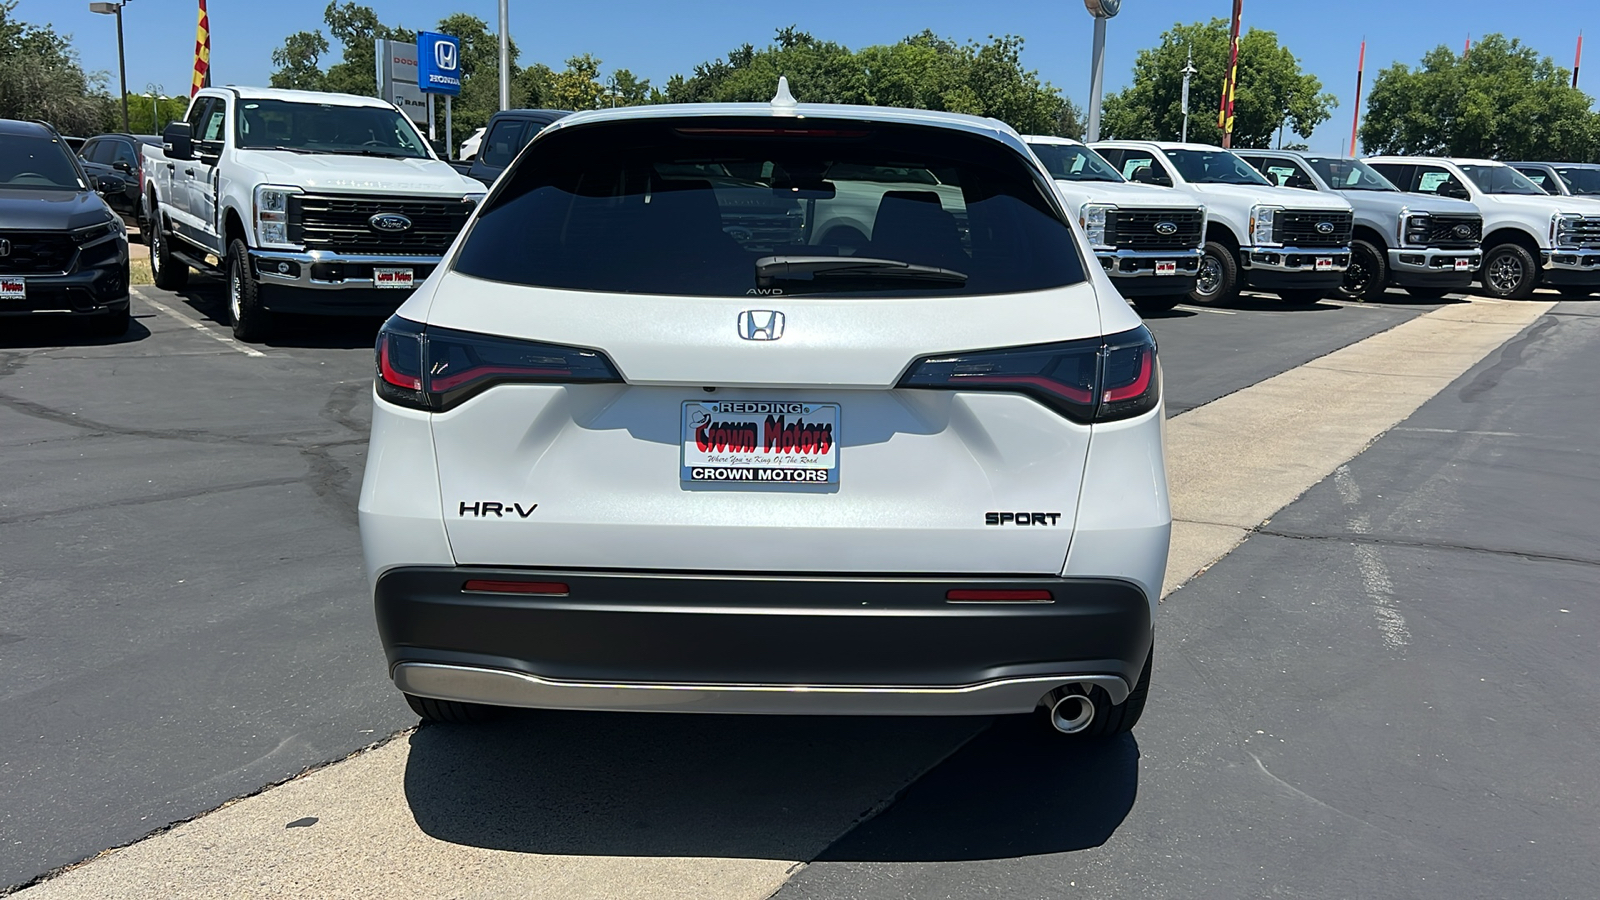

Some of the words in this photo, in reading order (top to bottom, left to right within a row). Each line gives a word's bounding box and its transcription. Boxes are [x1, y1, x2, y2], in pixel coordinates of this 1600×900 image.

[394, 57, 418, 66] DODG
[429, 74, 460, 85] HONDA
[404, 99, 426, 108] RAM
[381, 218, 403, 229] Ford
[720, 403, 801, 413] REDDING
[695, 413, 758, 454] Crown
[763, 414, 833, 455] Motors
[707, 454, 728, 463] Where
[729, 455, 752, 466] You're
[754, 455, 771, 464] King
[773, 455, 783, 465] Of
[785, 455, 798, 464] The
[799, 456, 819, 464] Road
[692, 468, 753, 480] CROWN
[758, 469, 828, 481] MOTORS
[459, 501, 538, 518] HR-V
[985, 512, 1061, 526] SPORT
